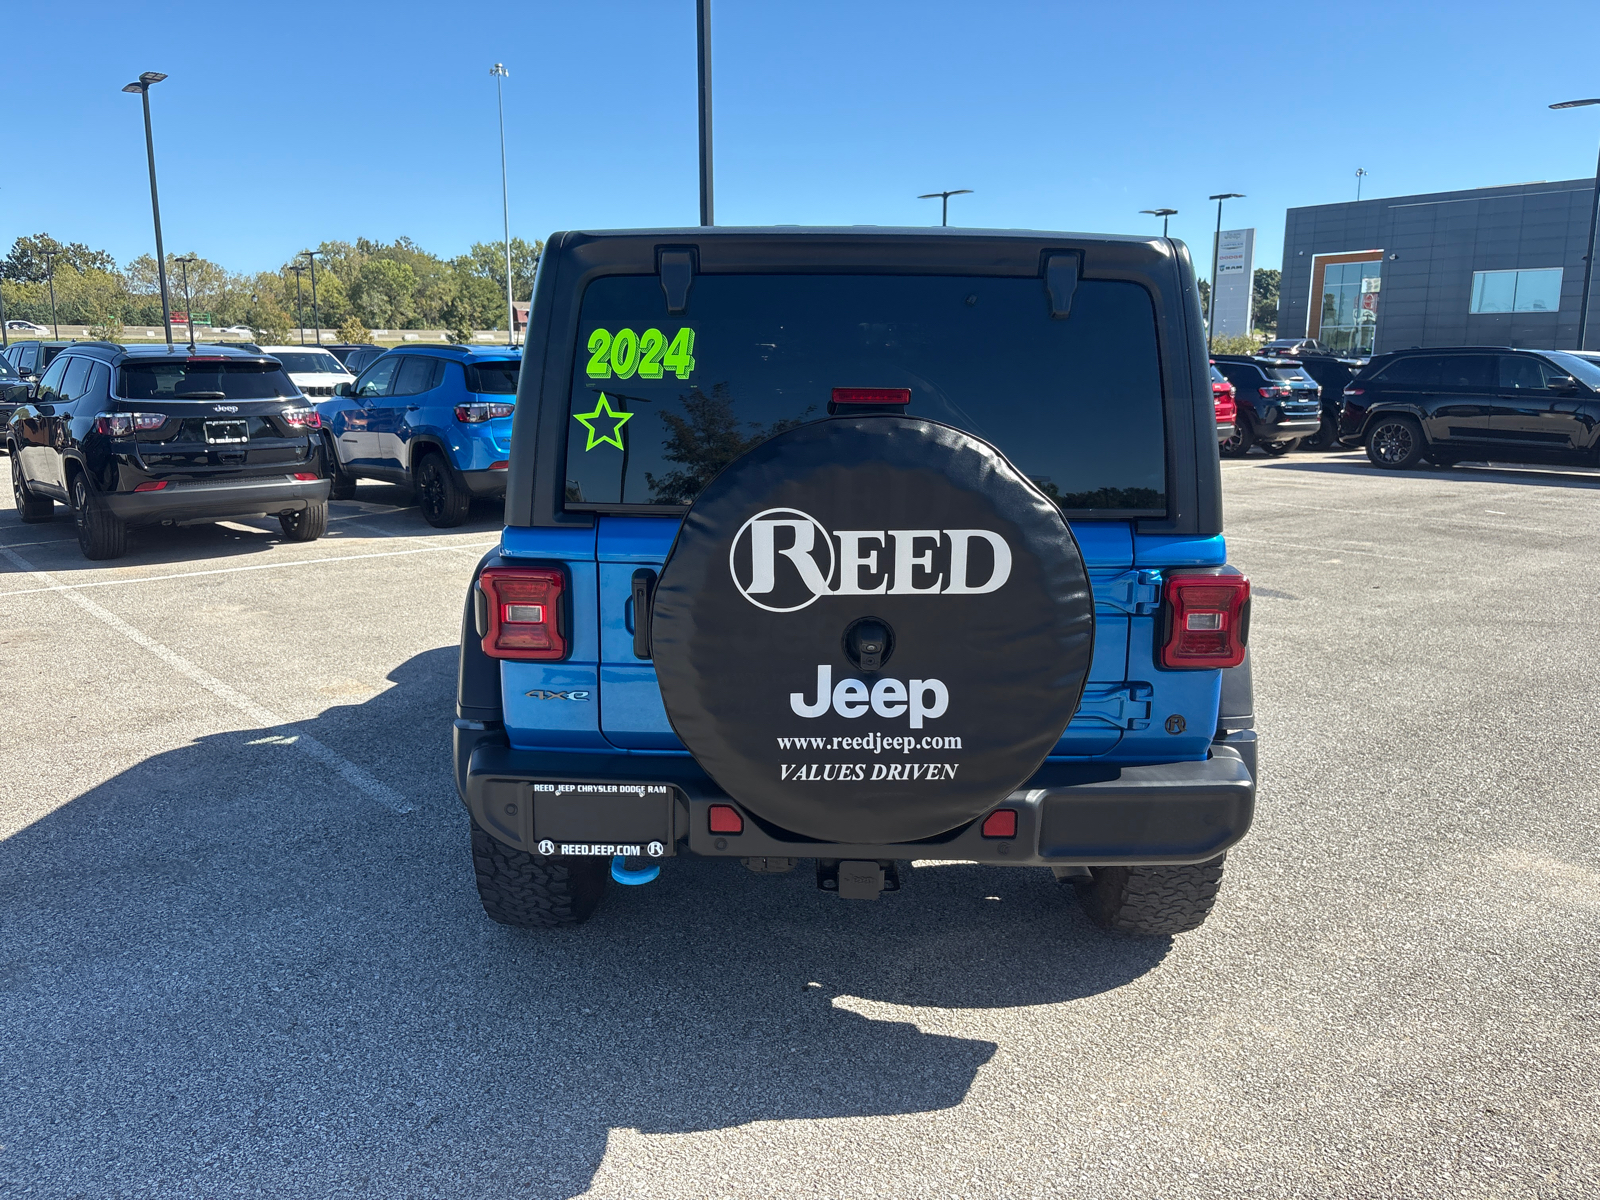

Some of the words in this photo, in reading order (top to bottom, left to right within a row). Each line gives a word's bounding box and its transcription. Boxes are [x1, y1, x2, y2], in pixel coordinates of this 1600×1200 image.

[586, 327, 696, 380] 2024
[213, 404, 239, 413] Jeep
[742, 517, 1013, 598] REED
[790, 664, 950, 729] Jeep
[776, 732, 963, 754] www.reedjeep.com
[779, 763, 866, 781] VALUES
[869, 762, 960, 781] DRIVEN
[534, 784, 555, 792] REED
[557, 785, 576, 793] JEEP
[577, 785, 618, 793] CHRYSLER
[619, 785, 646, 794] DODGE
[647, 786, 667, 794] RAM
[561, 844, 641, 857] REEDJEEP.COM
